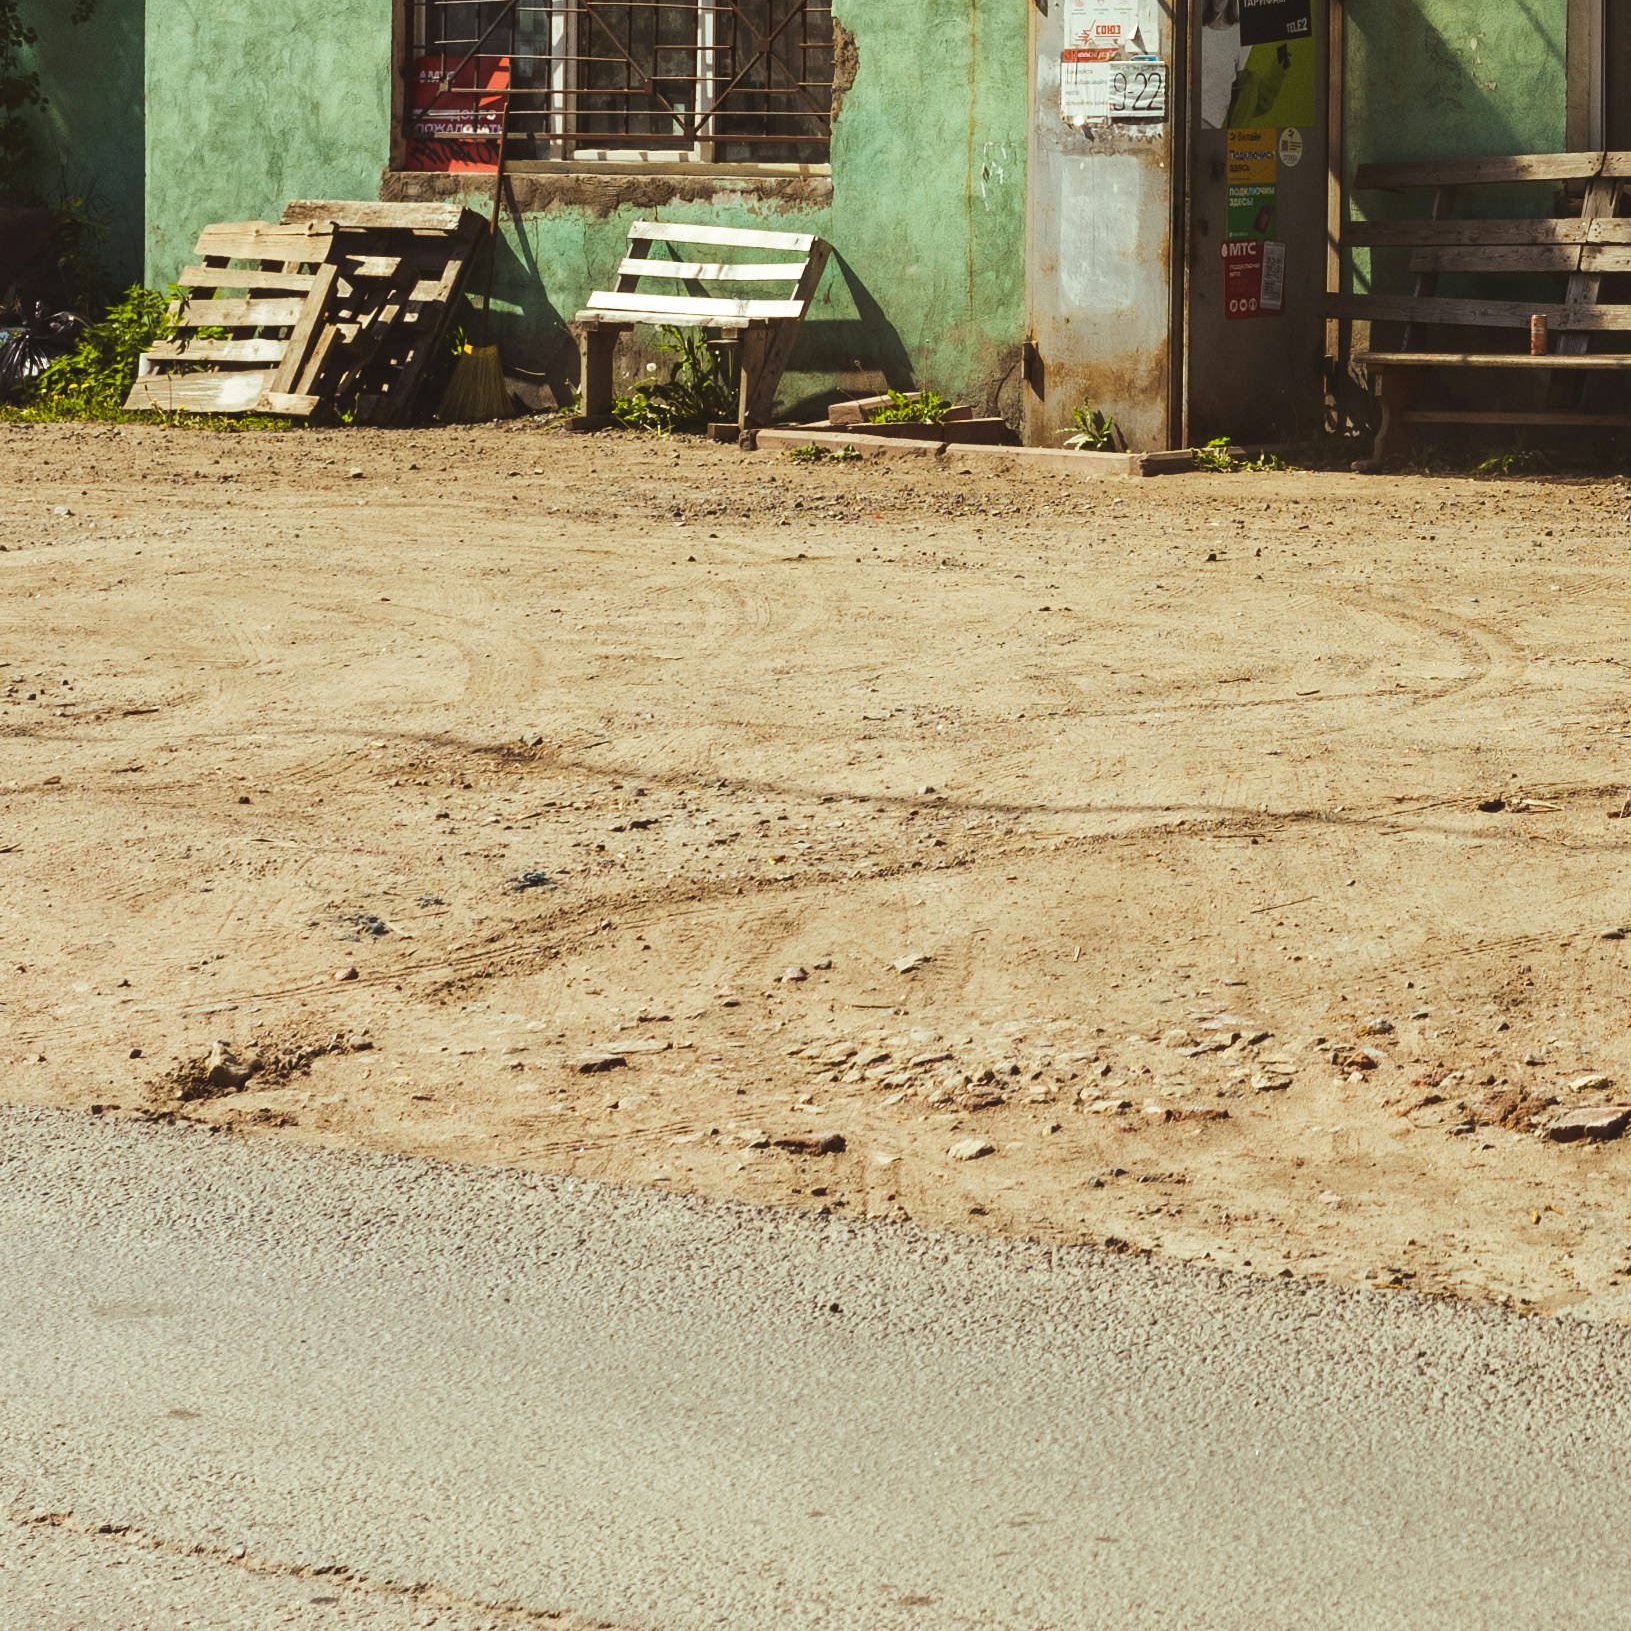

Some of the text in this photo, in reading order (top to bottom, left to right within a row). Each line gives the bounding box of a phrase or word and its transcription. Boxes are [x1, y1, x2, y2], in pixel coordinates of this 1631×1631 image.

[1095, 24, 1121, 35] СОЮЗ
[1286, 17, 1308, 33] TELE2
[1113, 72, 1163, 111] 9-22
[450, 110, 498, 122] ДОРО
[1229, 242, 1257, 257] МТС
